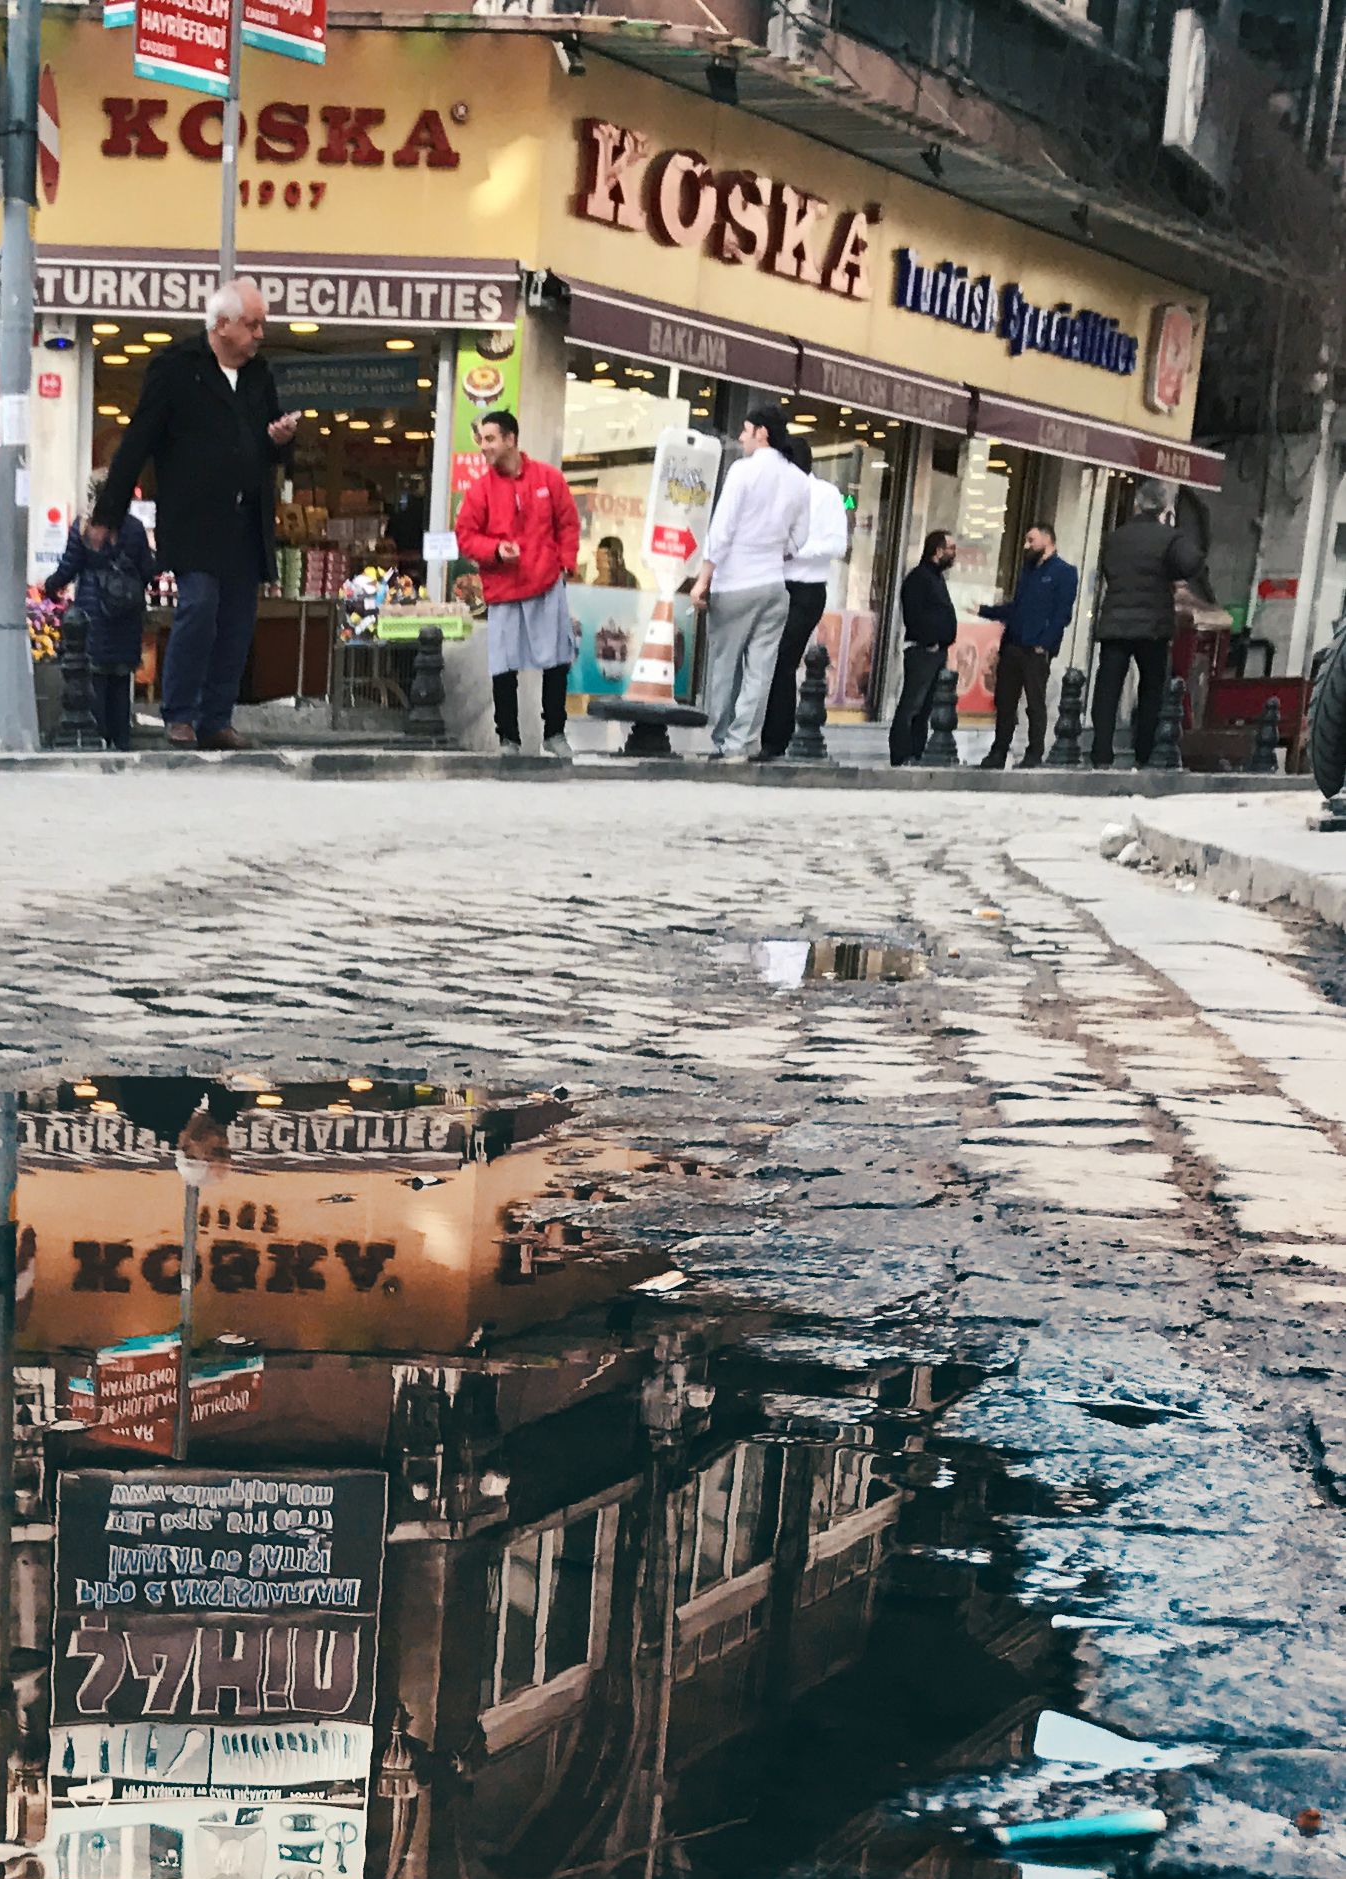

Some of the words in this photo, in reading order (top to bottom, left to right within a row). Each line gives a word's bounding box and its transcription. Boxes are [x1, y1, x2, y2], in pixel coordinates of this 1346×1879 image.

[100, 98, 460, 168] KOSKA
[238, 179, 328, 209] 1907
[576, 117, 871, 300] KOSKA
[38, 268, 219, 310] TURKISH
[246, 274, 503, 322] PECIALITIES
[648, 321, 728, 369] BAKLAVA
